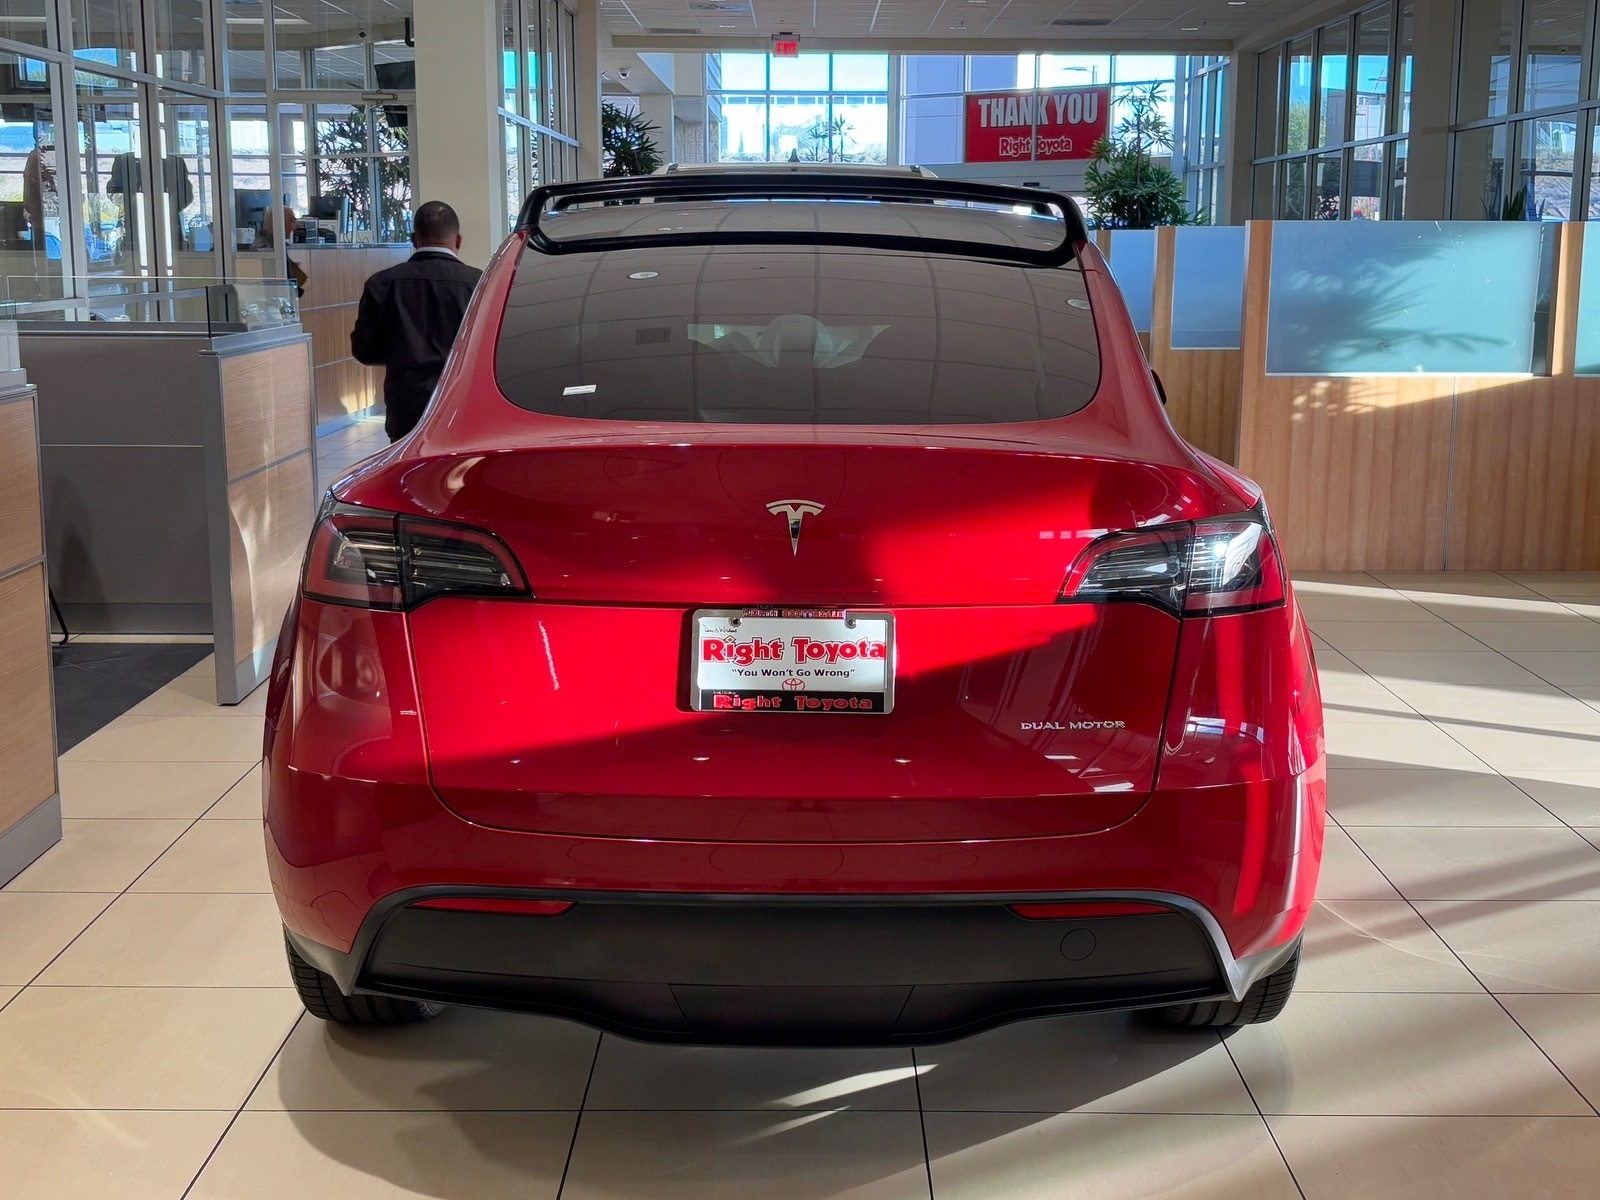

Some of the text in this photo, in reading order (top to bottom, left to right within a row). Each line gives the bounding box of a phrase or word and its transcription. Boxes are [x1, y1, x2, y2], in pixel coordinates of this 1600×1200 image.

[978, 92, 1098, 128] THANK YOU
[999, 136, 1032, 157] Right
[701, 635, 887, 666] Right Toyota
[761, 668, 793, 677] Won't
[796, 668, 811, 677] Go
[713, 693, 873, 710] Right Toyota
[1020, 721, 1125, 730] DUAL MOTOR
